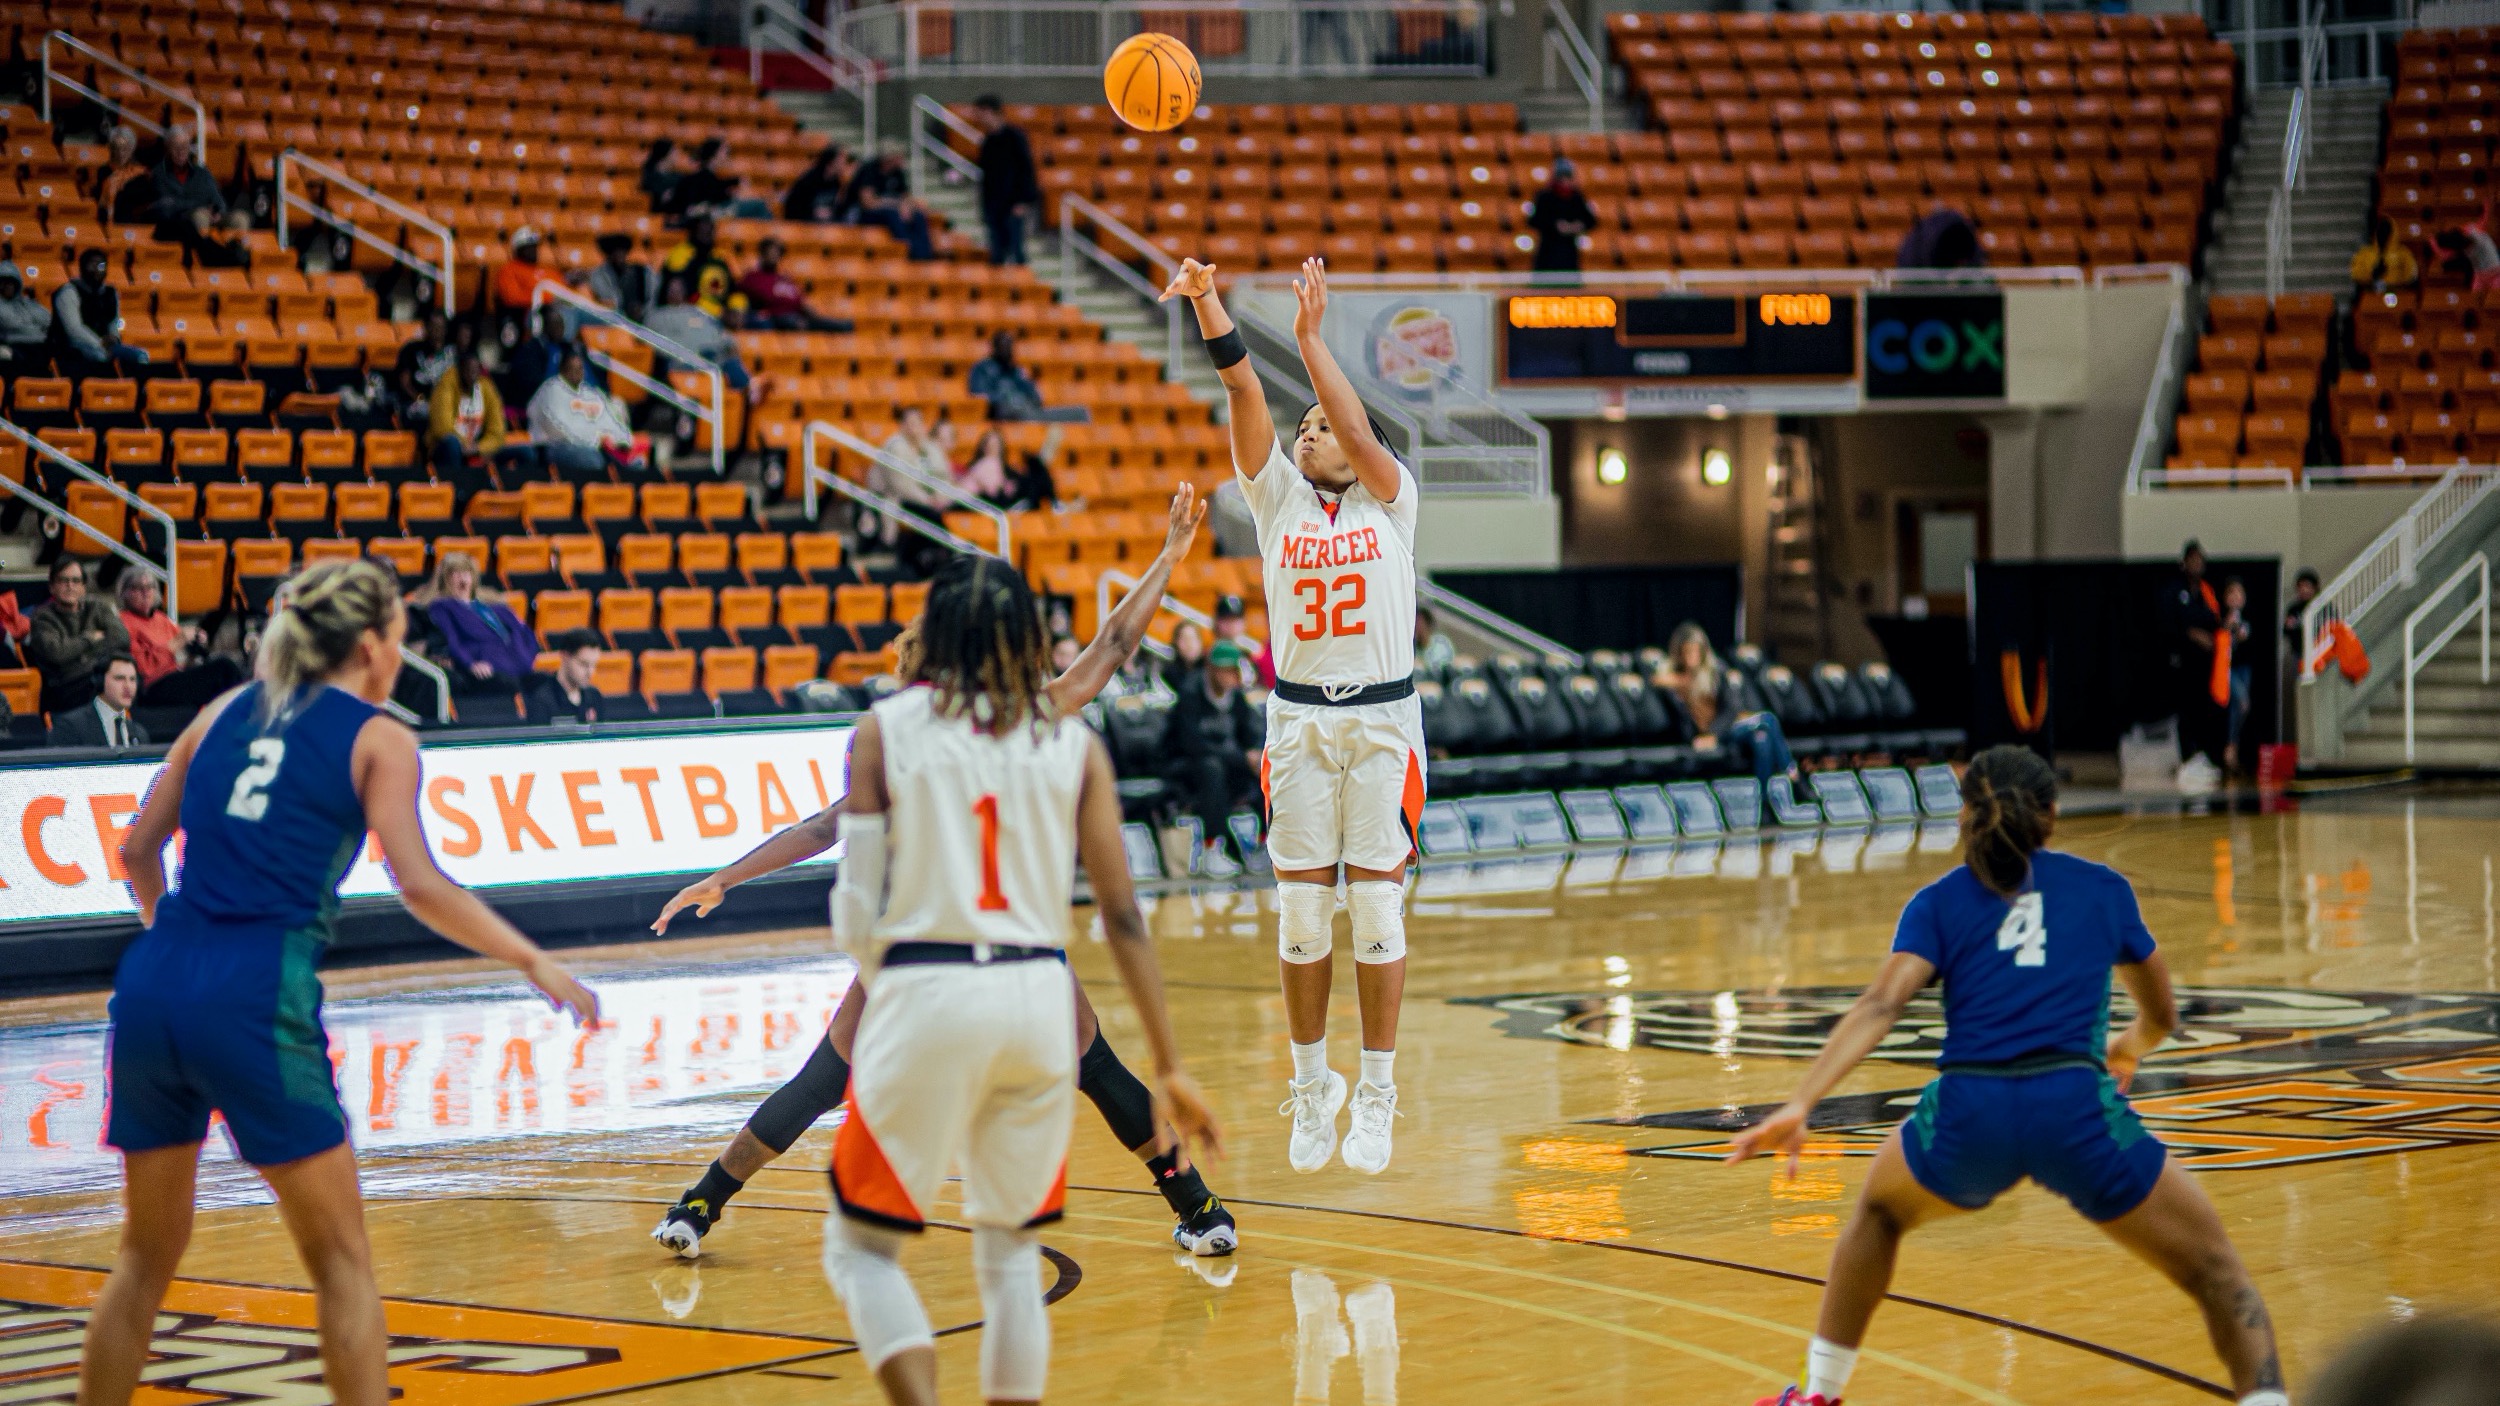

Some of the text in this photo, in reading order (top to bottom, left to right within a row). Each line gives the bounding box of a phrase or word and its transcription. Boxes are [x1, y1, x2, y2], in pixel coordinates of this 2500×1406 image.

[1869, 318, 2006, 375] COX
[1280, 526, 1382, 569] MERCER
[1293, 573, 1366, 641] 32
[226, 738, 285, 822] 2
[972, 794, 1008, 911] 1
[1997, 891, 2047, 967] 4
